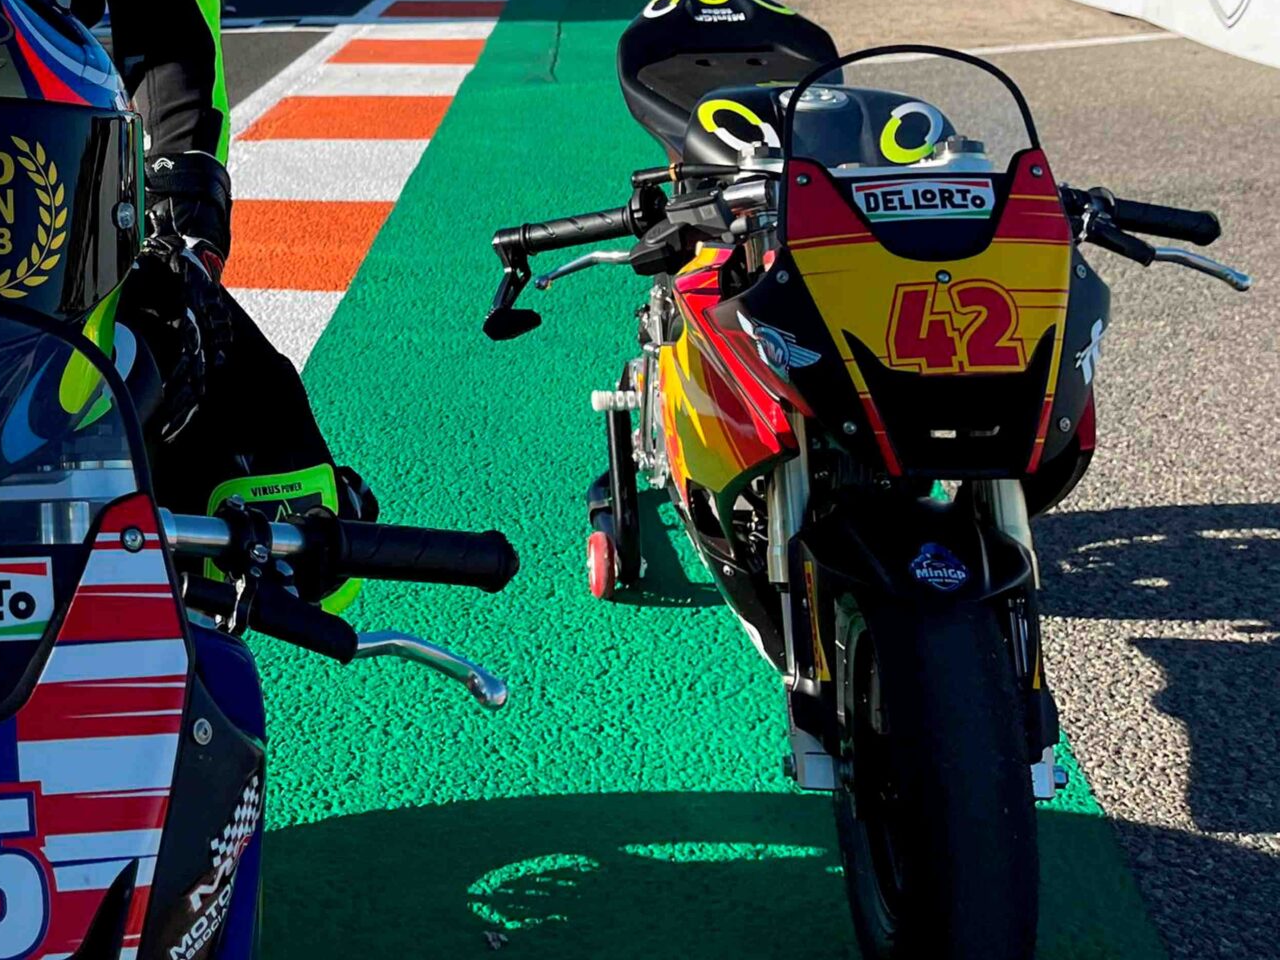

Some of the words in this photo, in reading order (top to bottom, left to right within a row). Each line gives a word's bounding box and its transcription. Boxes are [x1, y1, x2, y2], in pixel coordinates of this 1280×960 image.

[888, 280, 1025, 373] 42
[250, 484, 281, 497] VIRUS
[281, 481, 303, 493] POWER
